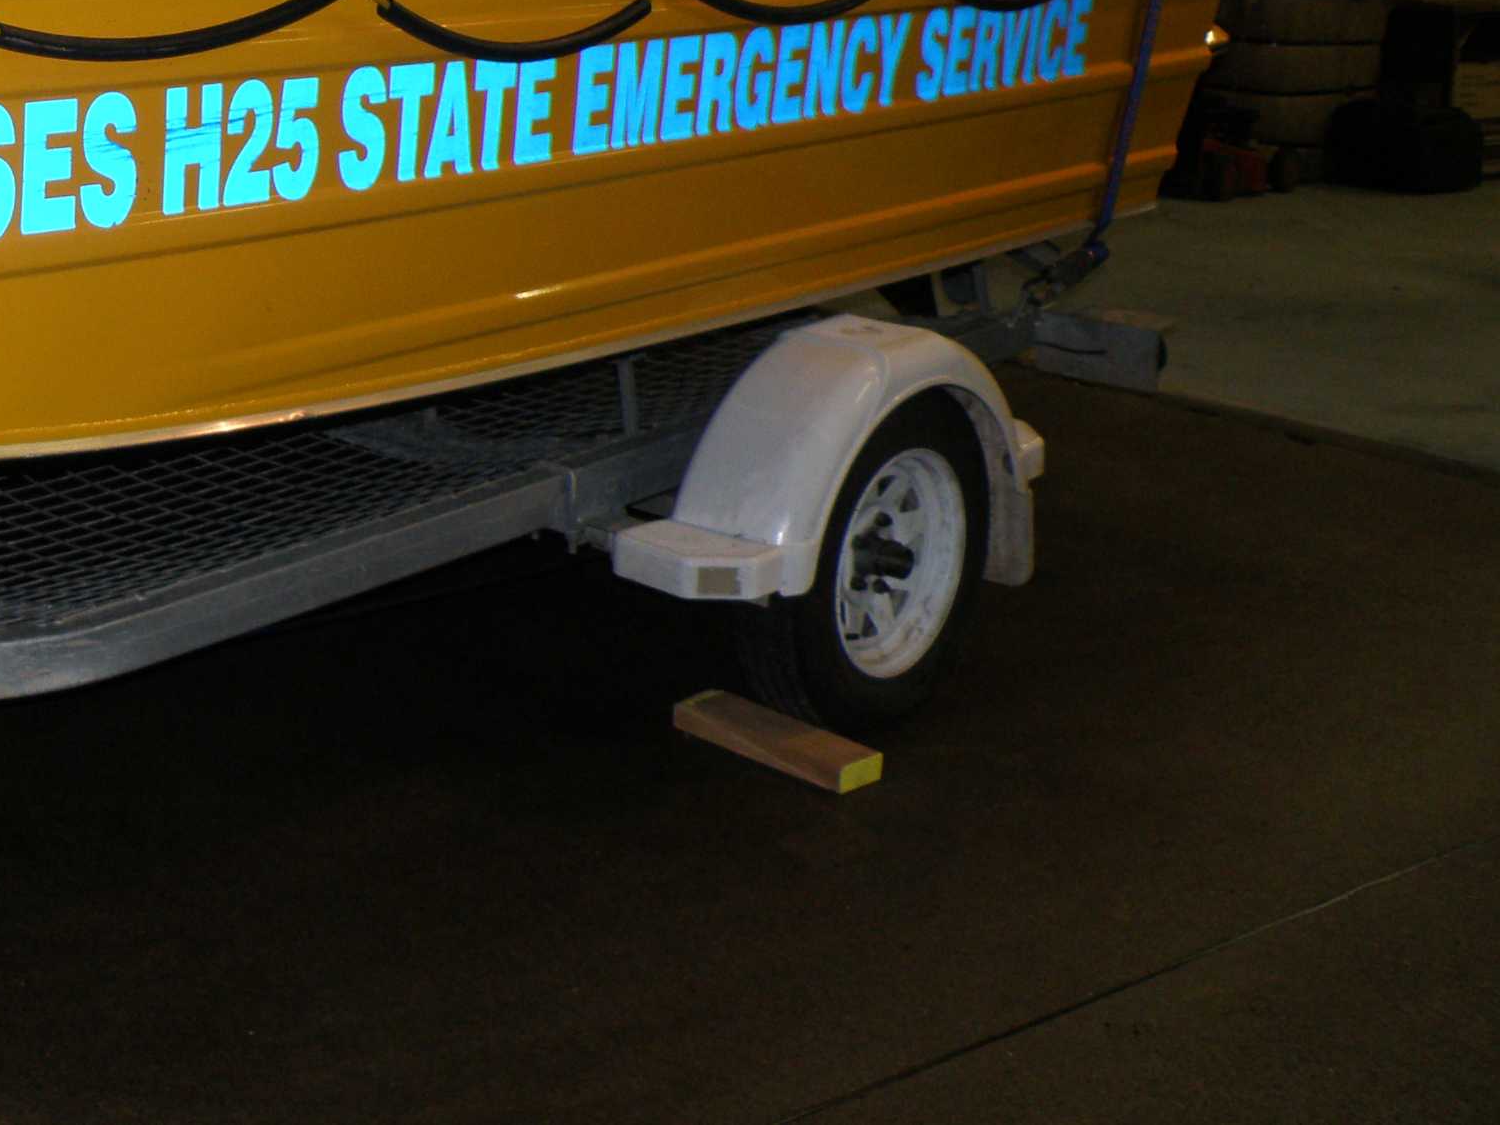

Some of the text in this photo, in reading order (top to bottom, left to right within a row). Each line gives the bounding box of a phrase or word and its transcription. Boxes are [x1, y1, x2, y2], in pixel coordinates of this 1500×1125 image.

[162, 78, 320, 216] H25
[337, 57, 558, 191] STATE
[572, 13, 913, 157] EMERGENCY
